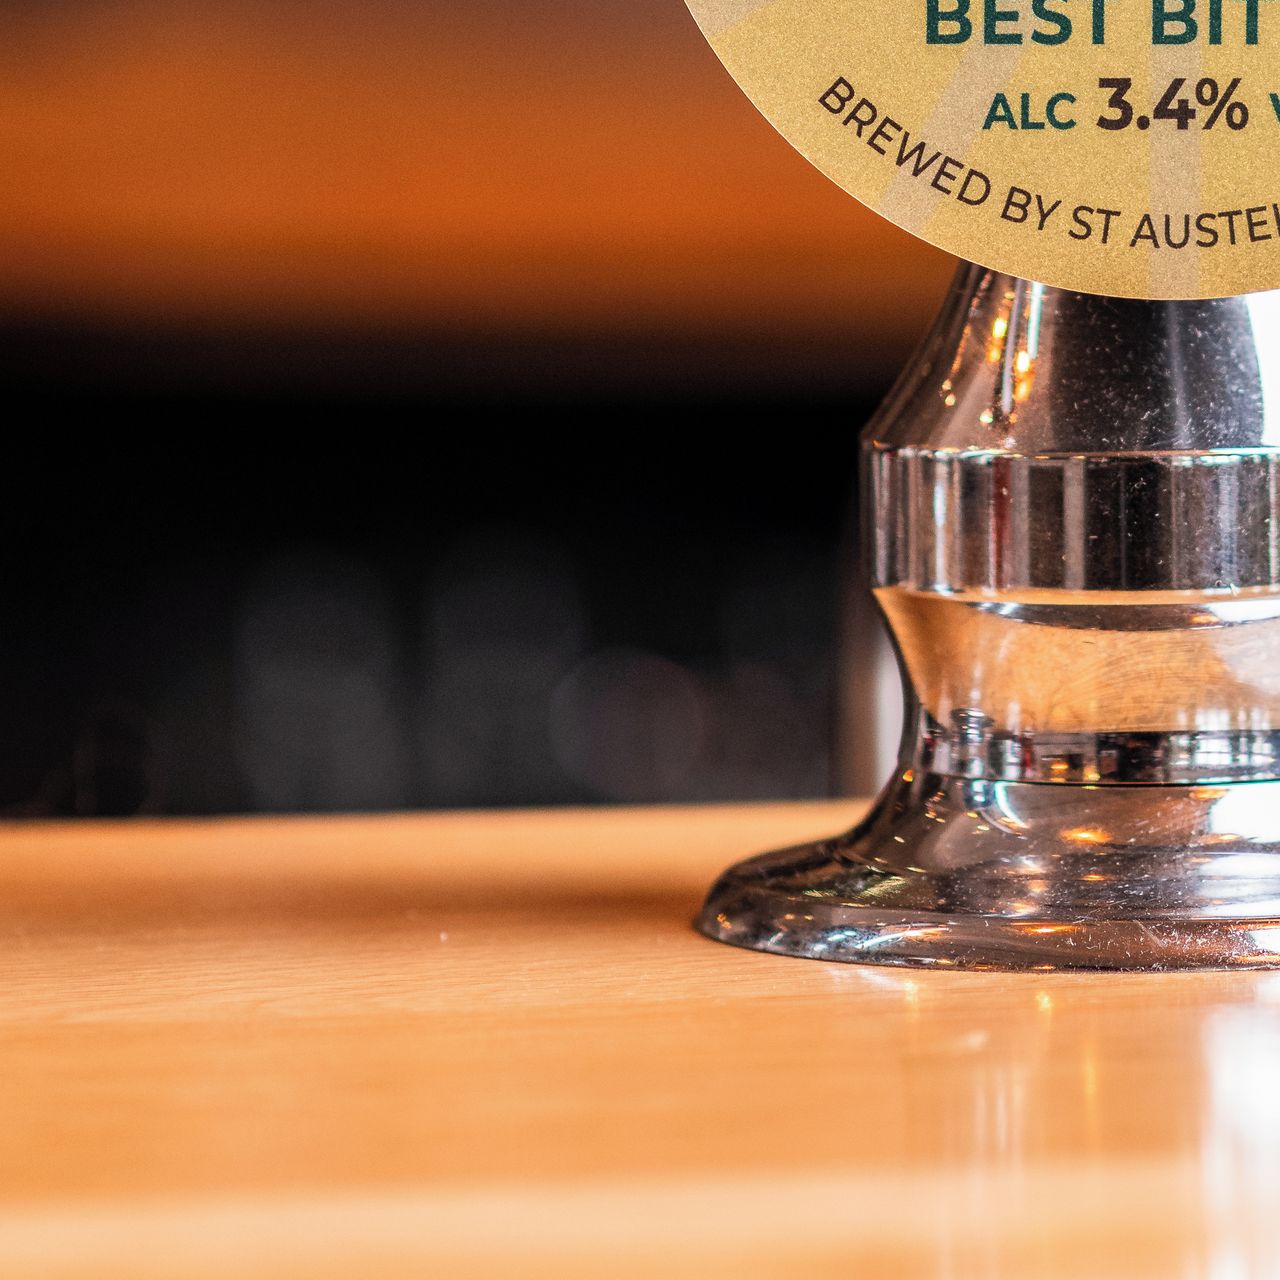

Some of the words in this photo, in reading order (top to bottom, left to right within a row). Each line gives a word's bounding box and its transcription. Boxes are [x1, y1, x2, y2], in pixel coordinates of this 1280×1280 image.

[983, 93, 1076, 130] ALC
[1097, 78, 1248, 130] 3.4%
[819, 77, 990, 205] BREWED
[1002, 187, 1060, 230] BY
[1070, 206, 1120, 243] ST
